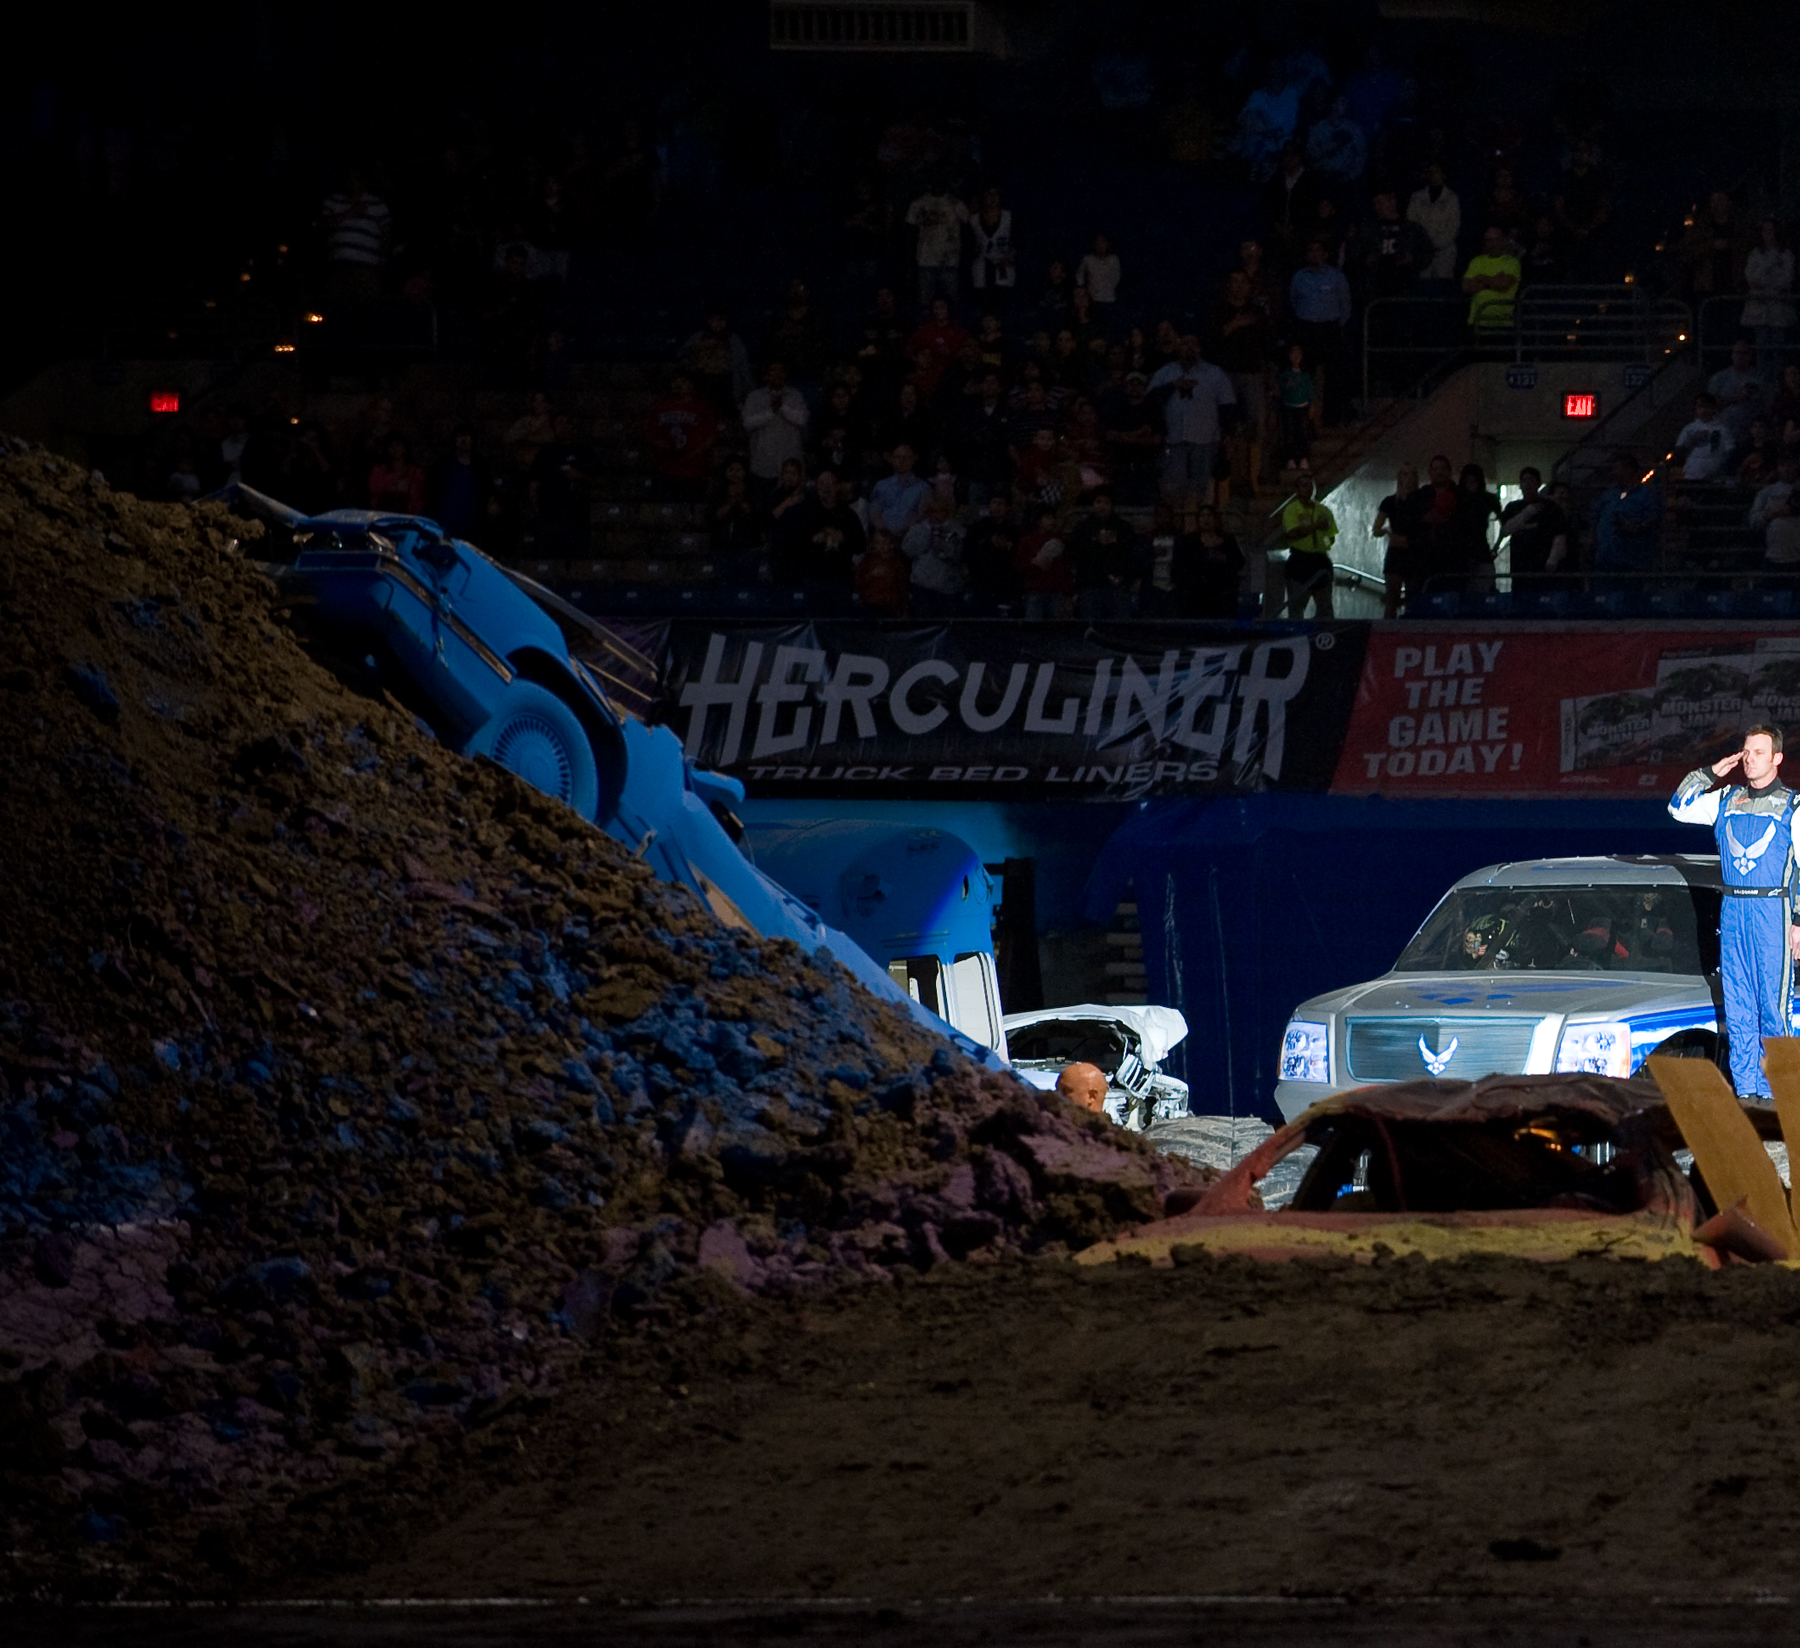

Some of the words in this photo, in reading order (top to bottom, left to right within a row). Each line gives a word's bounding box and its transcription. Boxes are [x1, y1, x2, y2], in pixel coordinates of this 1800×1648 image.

[1567, 395, 1593, 416] EXIT
[1394, 640, 1504, 678] PLAY
[680, 632, 1311, 782] HERCULINER
[1405, 677, 1485, 709] THE
[1388, 706, 1510, 748] GAME
[745, 764, 913, 783] TRUCK
[929, 764, 1028, 782] BED
[1045, 759, 1219, 784] LINERS
[1363, 742, 1524, 779] TODAY!
